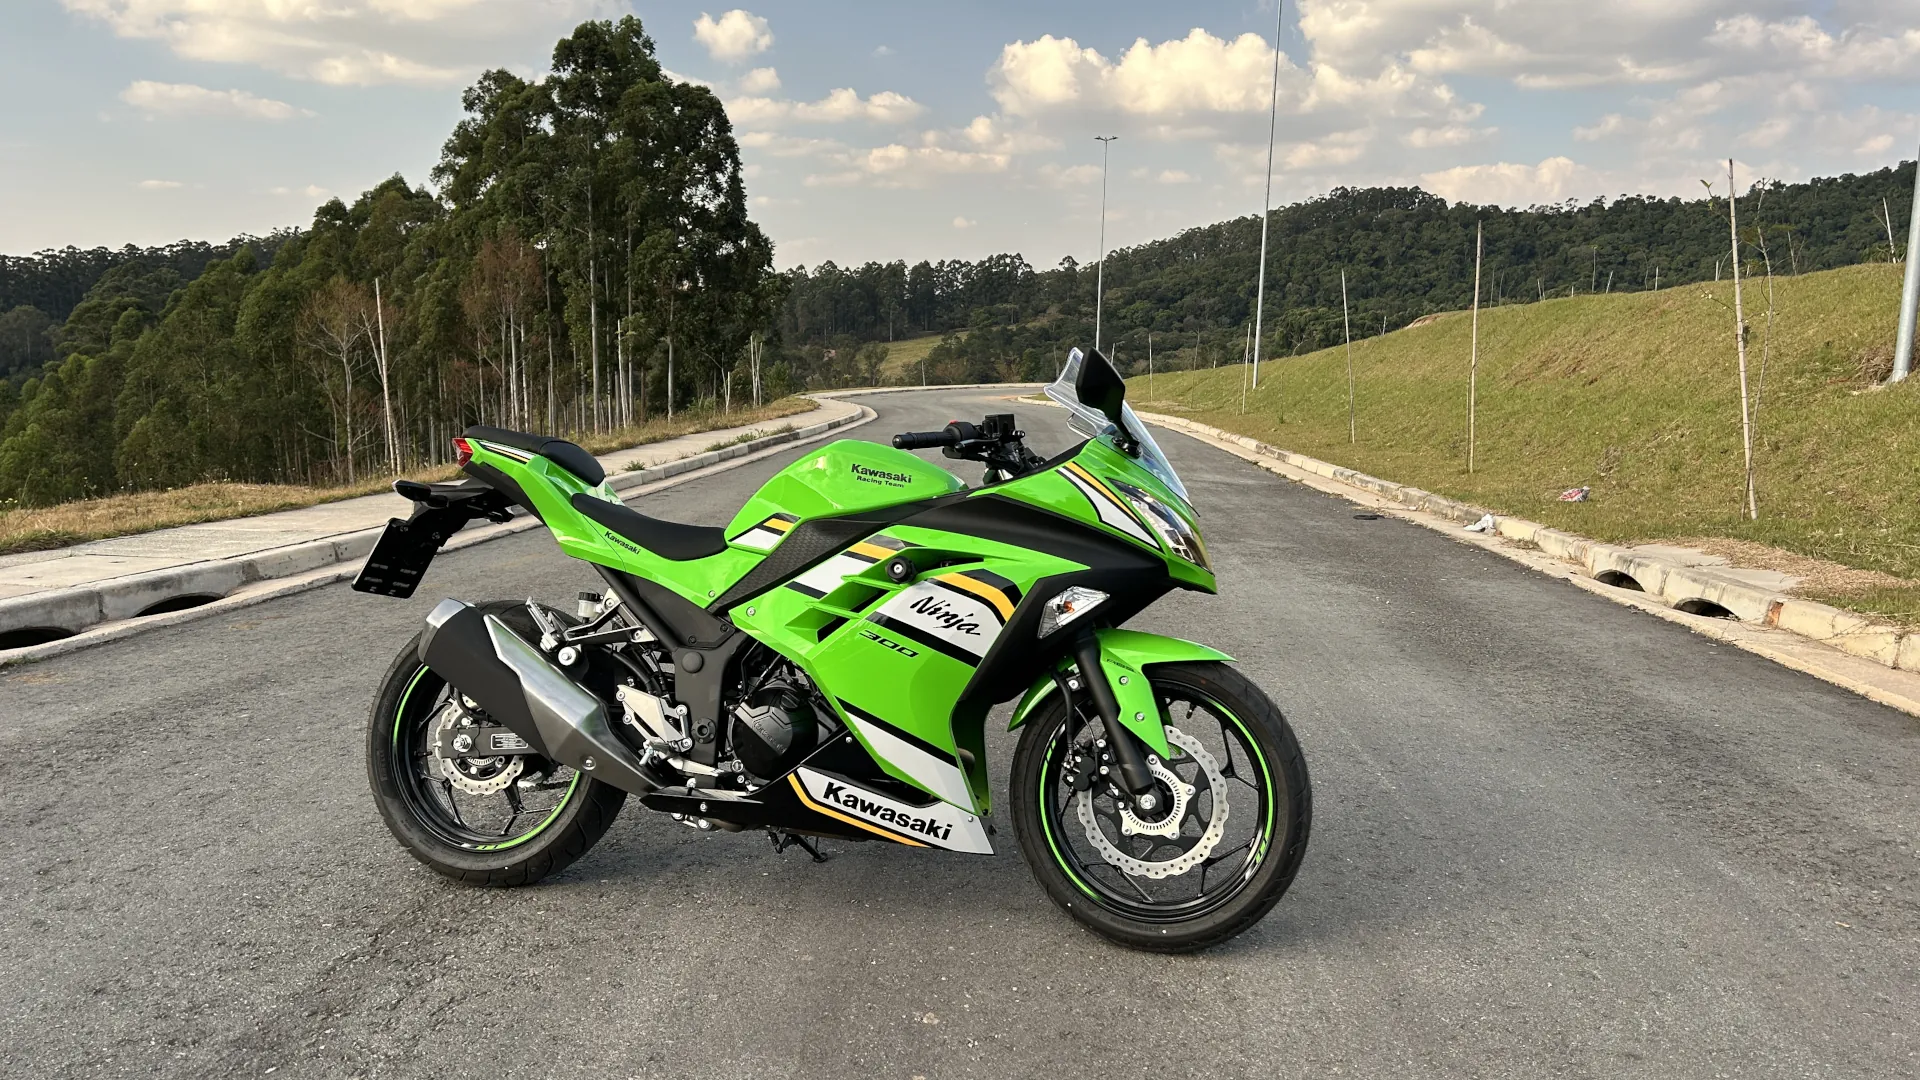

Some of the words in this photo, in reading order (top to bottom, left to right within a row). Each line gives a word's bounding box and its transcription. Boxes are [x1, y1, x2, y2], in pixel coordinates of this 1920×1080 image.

[851, 463, 912, 483] Kawasaki
[856, 475, 882, 485] Racing
[885, 480, 904, 488] Team
[605, 530, 641, 555] Kawasaki
[910, 596, 981, 636] Ninja
[859, 629, 919, 658] 300
[823, 781, 953, 841] Kawasaki
